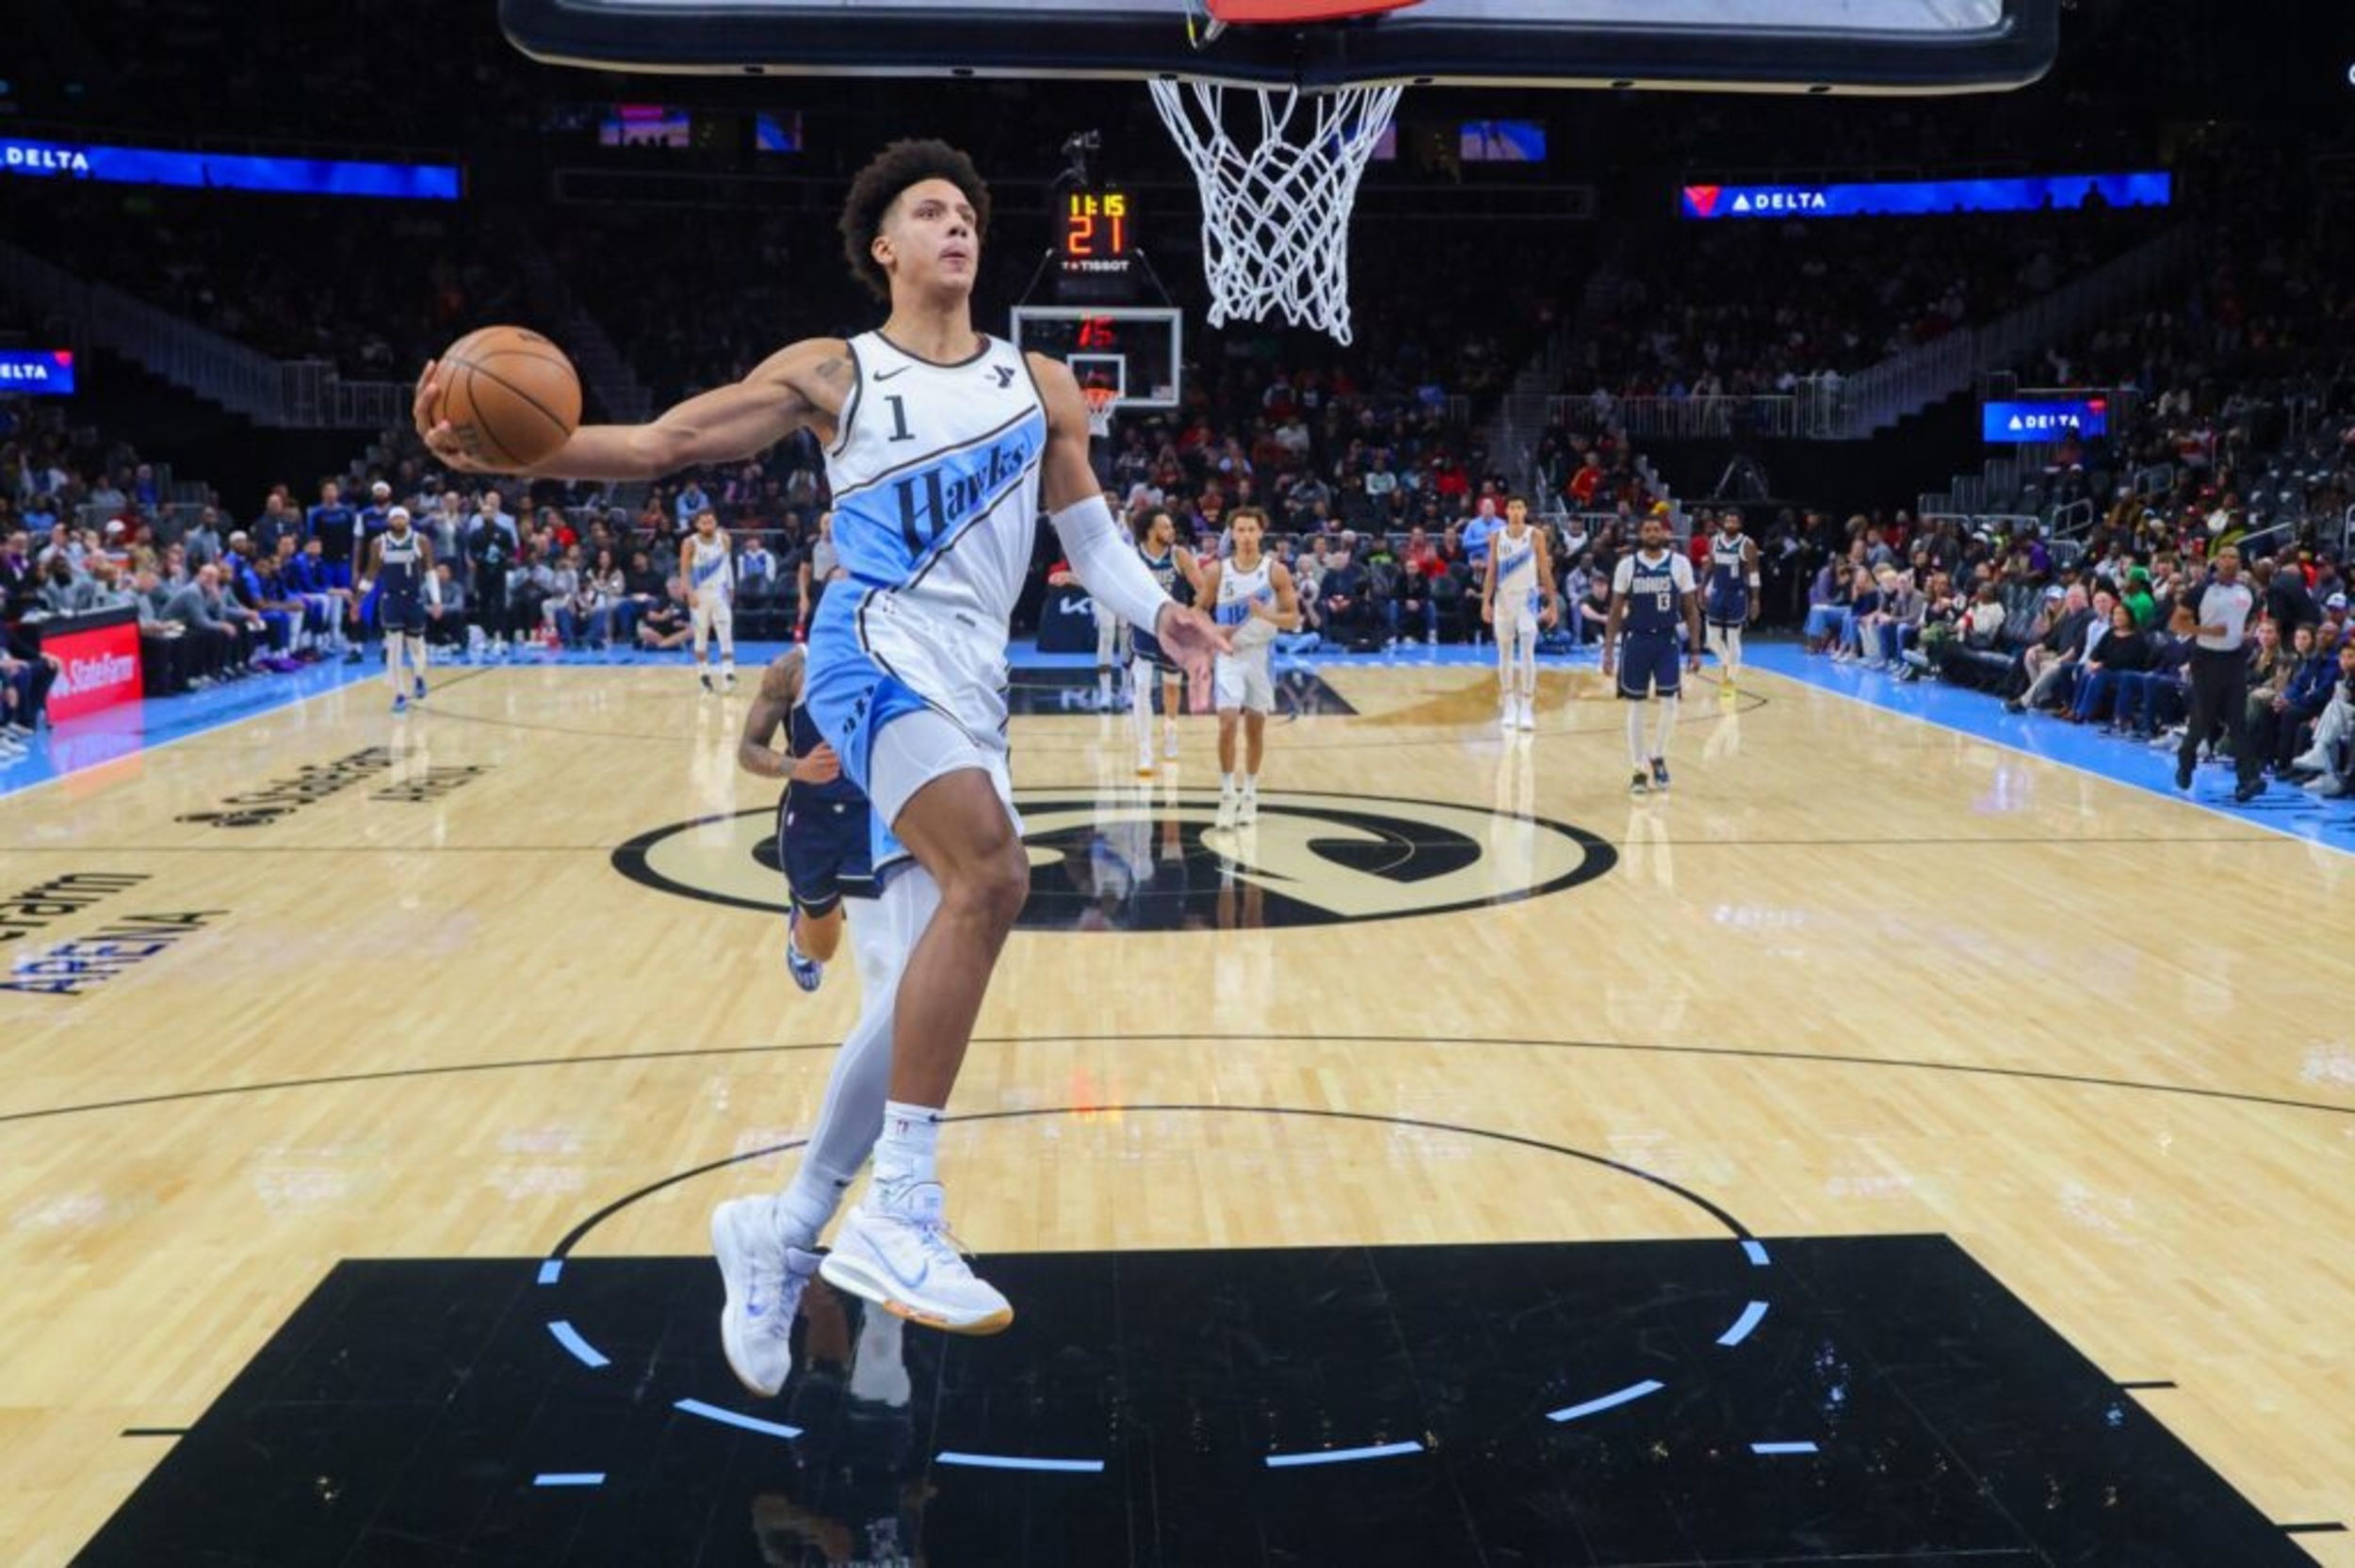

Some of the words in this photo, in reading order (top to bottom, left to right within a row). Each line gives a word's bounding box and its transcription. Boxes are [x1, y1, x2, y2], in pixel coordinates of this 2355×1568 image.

[6, 147, 89, 170] DELTA
[1070, 194, 1125, 217] 11:15
[1756, 192, 1827, 209] DELTA
[1069, 217, 1121, 253] 21
[1080, 260, 1129, 271] TISSOT
[0, 364, 48, 380] ELTA
[884, 395, 916, 443] 1
[893, 445, 1025, 559] Hawks
[1658, 593, 1671, 611] 13
[0, 910, 231, 995] ARENA
